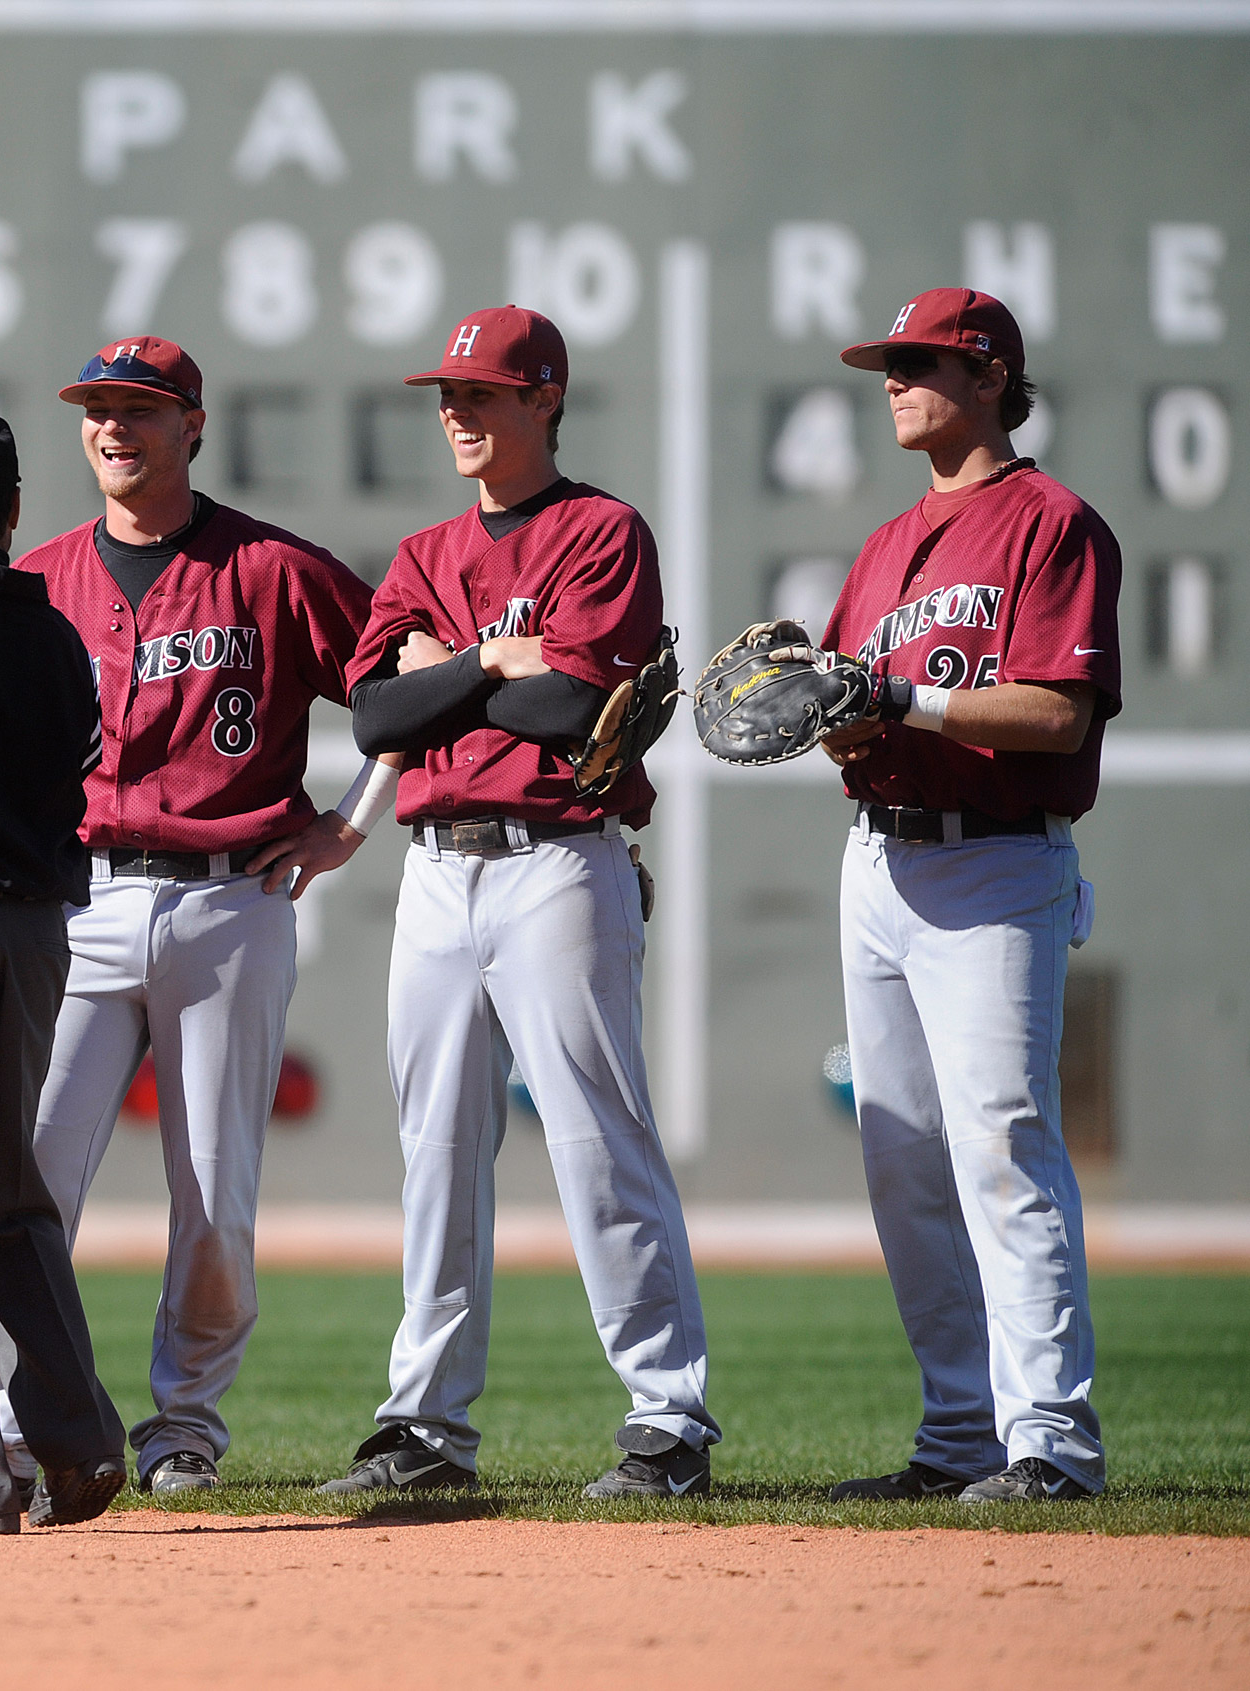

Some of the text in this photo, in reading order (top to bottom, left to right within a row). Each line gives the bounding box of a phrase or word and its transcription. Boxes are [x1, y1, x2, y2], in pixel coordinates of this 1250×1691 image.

[78, 70, 692, 184] PARK
[96, 219, 188, 336] 7
[222, 220, 317, 347] 8
[346, 219, 443, 344] 9
[507, 219, 640, 349] 10
[770, 219, 865, 344] R
[961, 219, 1057, 344] H
[1150, 221, 1227, 344] E
[889, 303, 917, 336] H
[450, 325, 481, 357] H
[772, 386, 860, 500] 4
[1150, 385, 1230, 509] 0
[93, 626, 256, 687] MSON
[856, 583, 1004, 670] RIMSON
[1169, 555, 1211, 680] 1
[211, 687, 256, 757] 8
